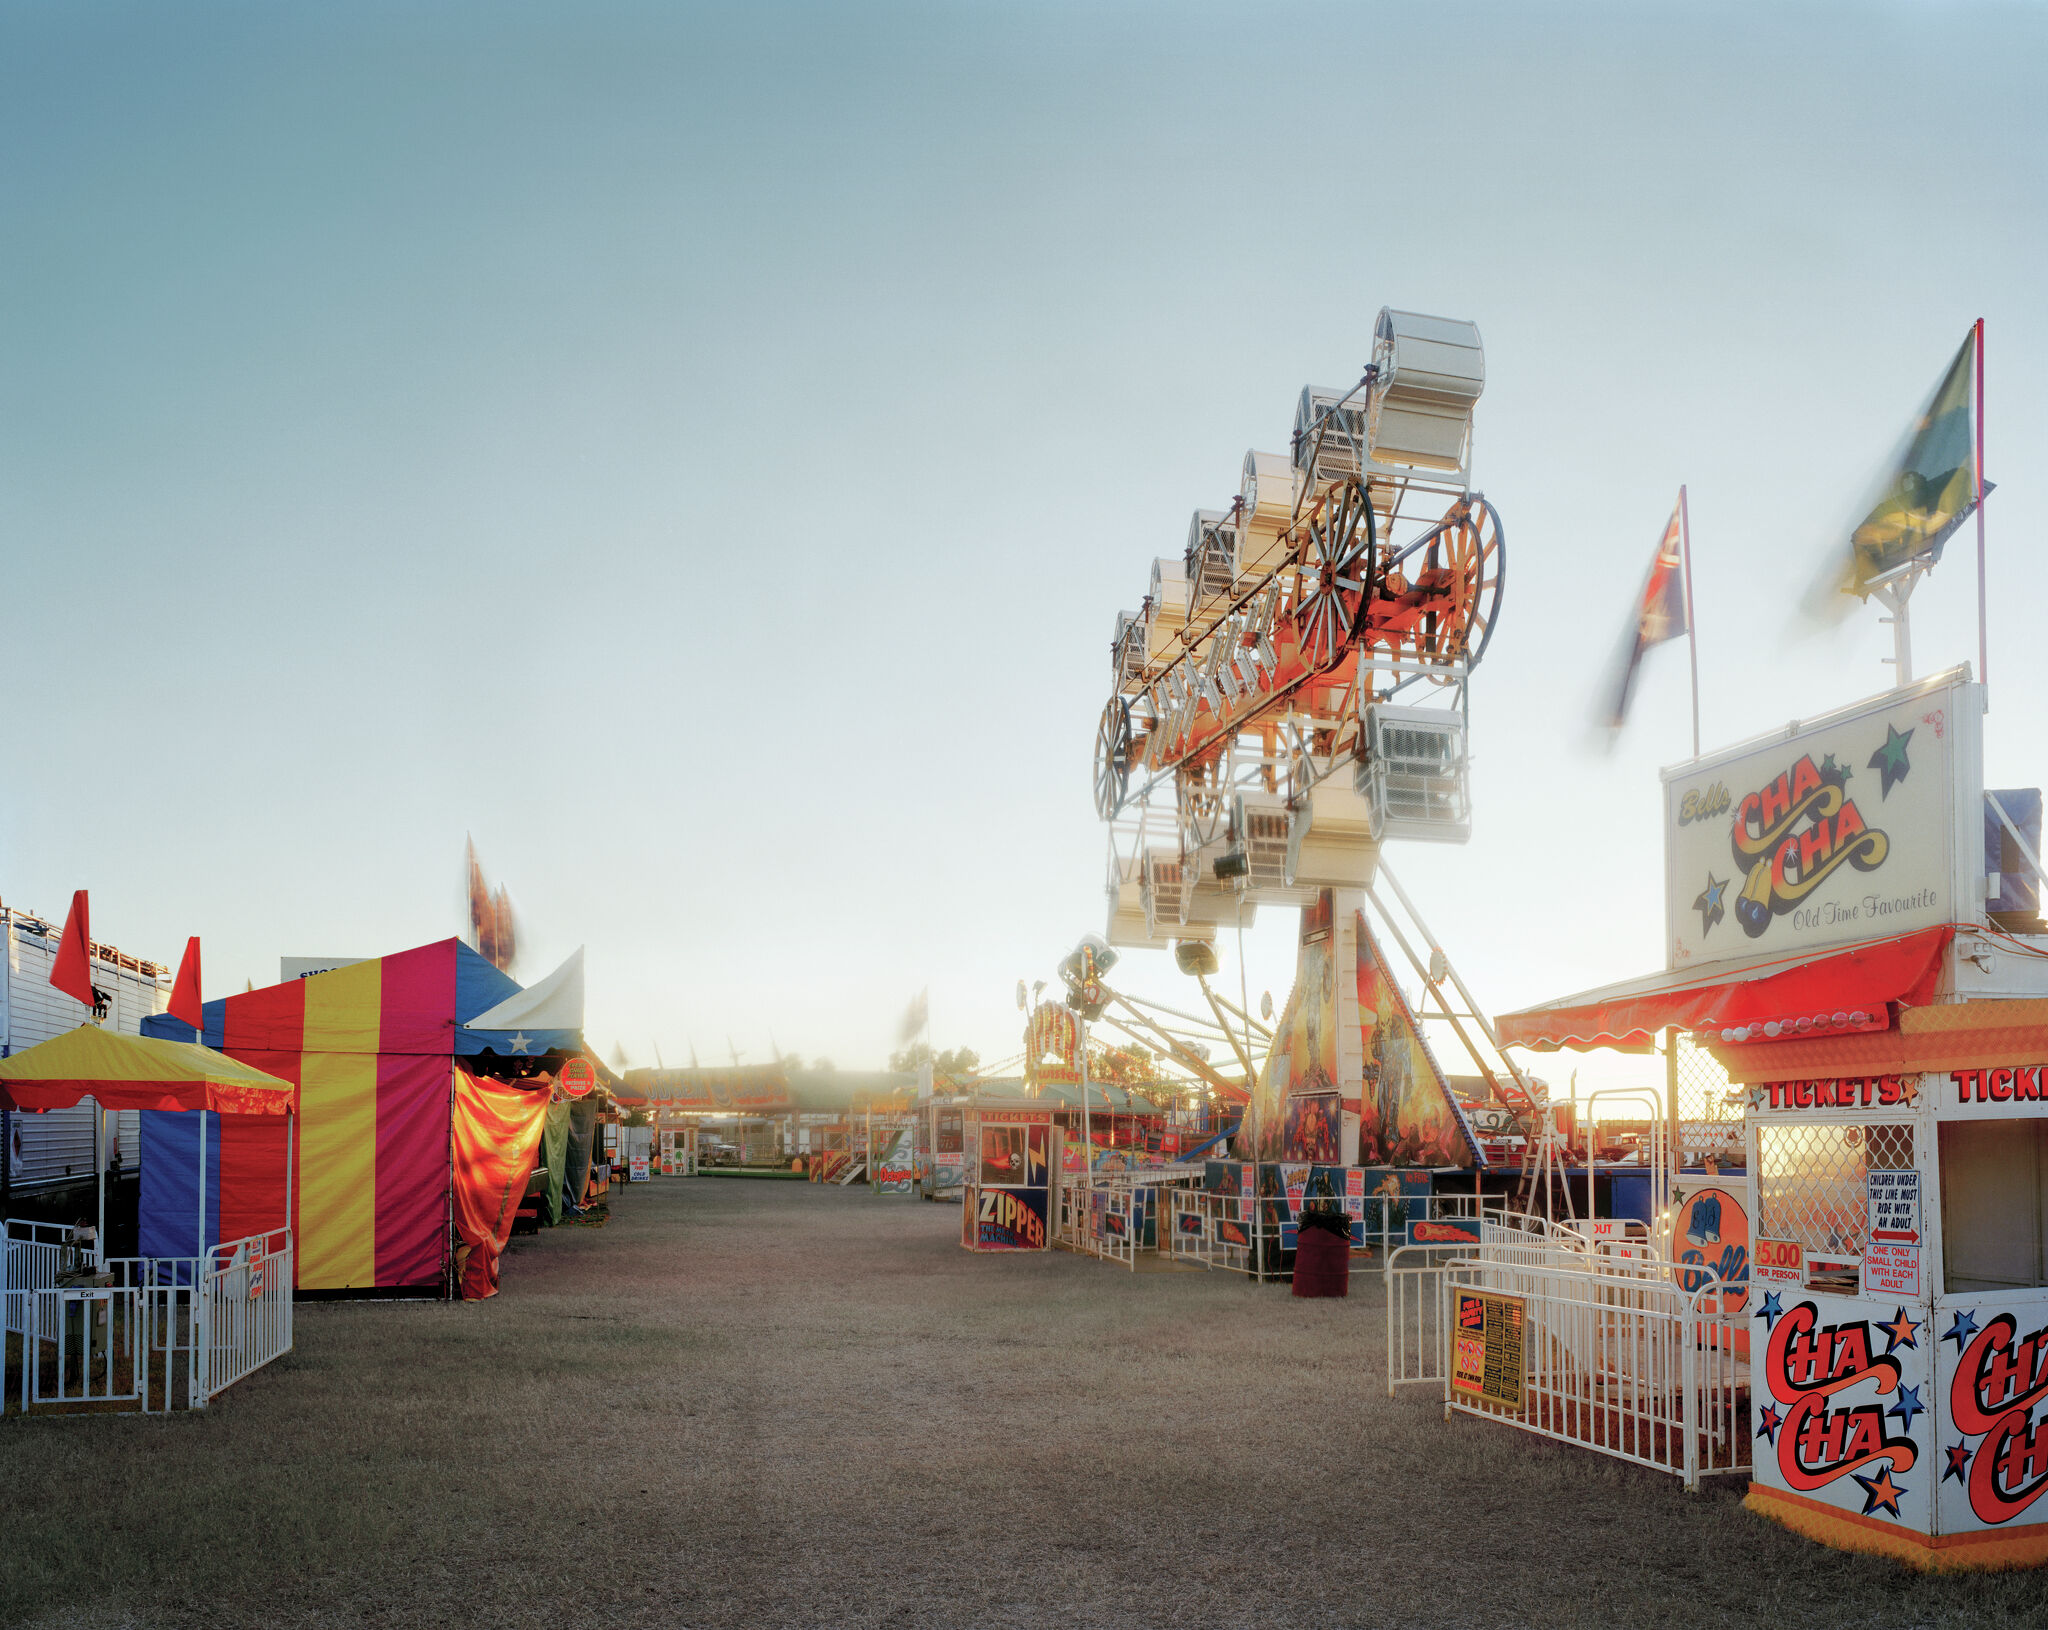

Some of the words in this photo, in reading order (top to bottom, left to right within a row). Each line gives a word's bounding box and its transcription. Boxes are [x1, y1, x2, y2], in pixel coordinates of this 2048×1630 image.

[1679, 781, 1730, 826] Bells
[1732, 753, 1844, 856] CHA
[1771, 798, 1889, 902] CHA
[1793, 907, 1820, 930] Old
[1823, 901, 1859, 925] Time
[1863, 888, 1937, 919] Favourite
[1763, 1074, 1902, 1109] TICKETS
[986, 1111, 1047, 1122] TICKETS
[1870, 1174, 1895, 1186] CHILDREN
[1897, 1174, 1918, 1187] UNDER
[1870, 1188, 1883, 1200] THIS
[1885, 1188, 1898, 1200] LINE
[1901, 1188, 1918, 1201] MUST
[1877, 1203, 1892, 1214] RIDE
[1894, 1203, 1911, 1215] WITH
[980, 1189, 1044, 1248] ZIPPER
[1878, 1217, 1888, 1229] AN
[1891, 1217, 1912, 1229] ADULT
[980, 1224, 994, 1233] THE
[980, 1232, 1018, 1248] MACHINE
[1621, 1249, 1632, 1258] IN
[1755, 1241, 1800, 1268] $5.00
[1873, 1246, 1889, 1255] ONE
[1891, 1247, 1910, 1257] ONLY
[1867, 1256, 1892, 1267] SMALL
[1894, 1258, 1917, 1269] CHILD
[1757, 1267, 1769, 1277] PER
[1771, 1269, 1800, 1280] PERSON
[1871, 1266, 1890, 1276] WITH
[1892, 1269, 1913, 1279] EACH
[1880, 1279, 1904, 1288] ADULT
[1766, 1301, 1902, 1406] CHA
[1950, 1312, 2048, 1437] CH
[1777, 1392, 1919, 1492] CHA
